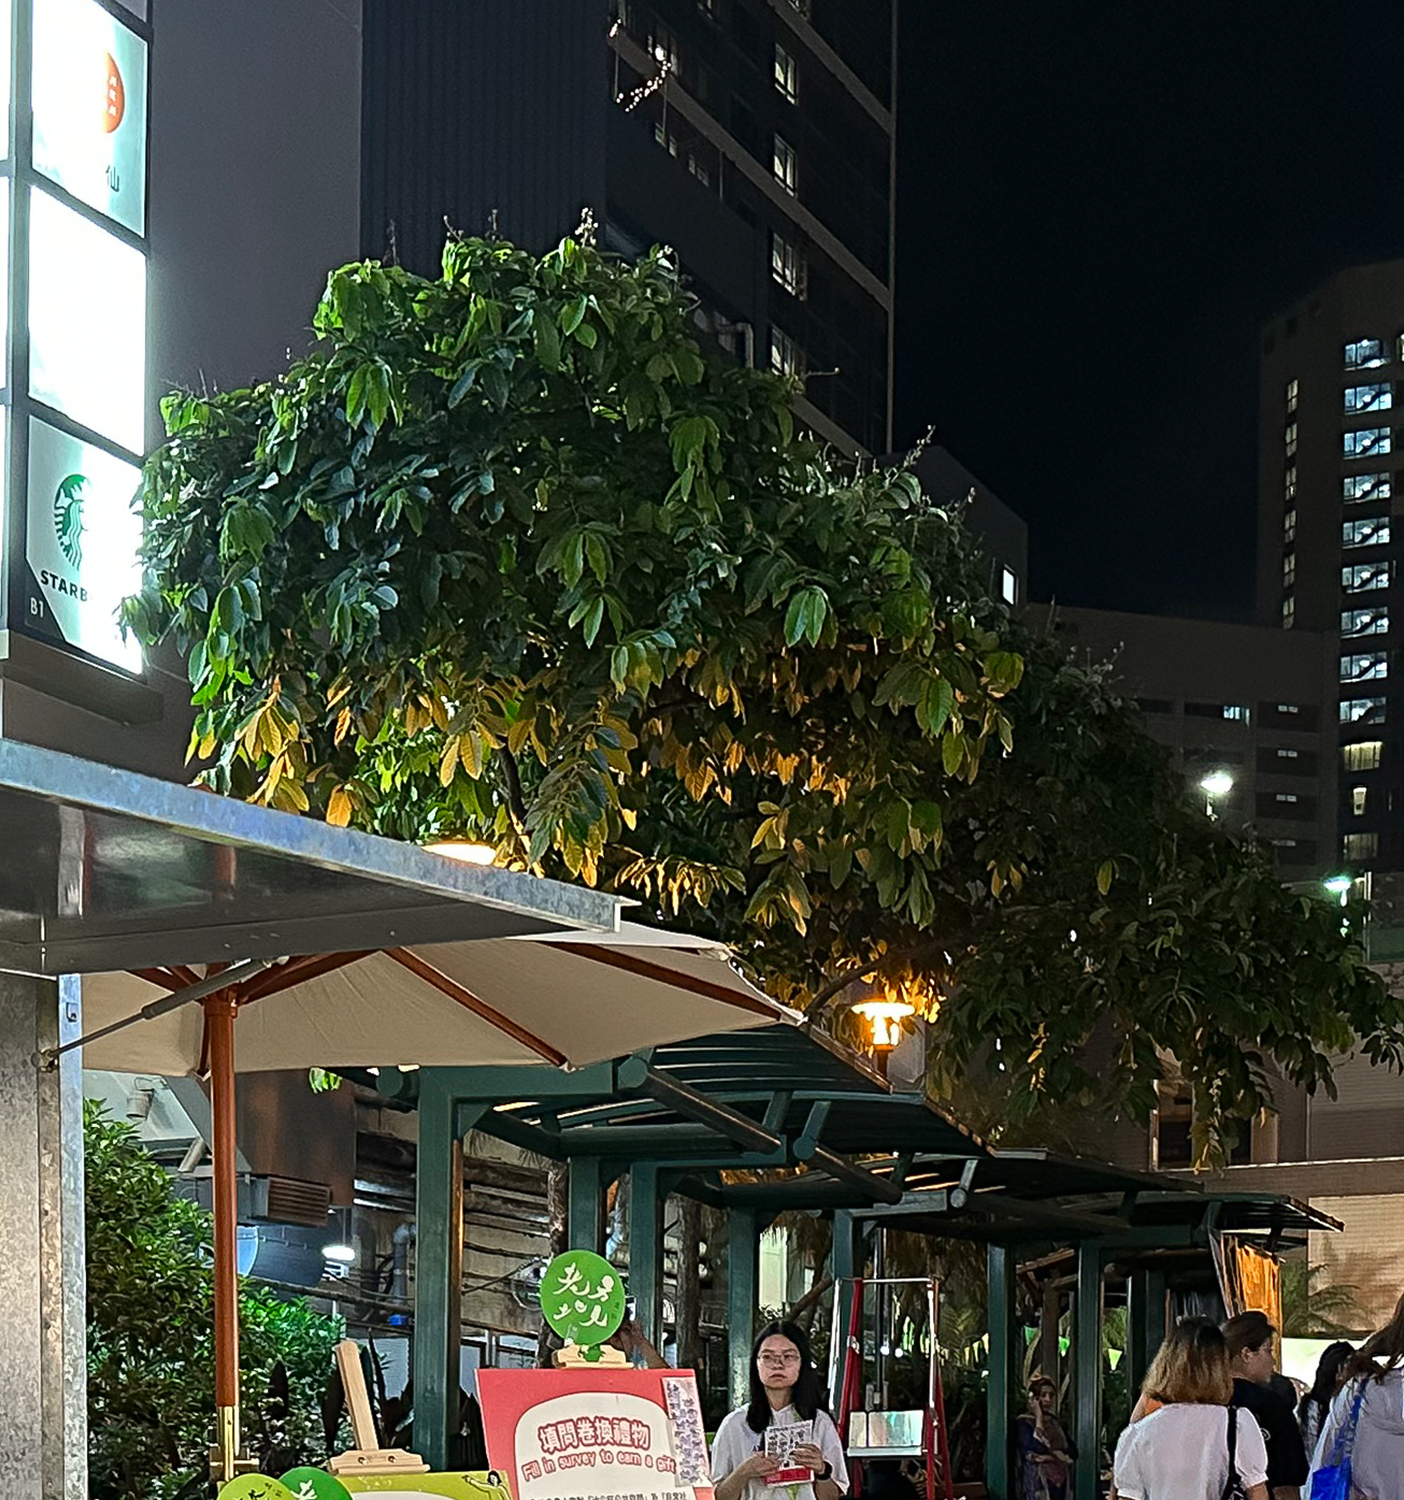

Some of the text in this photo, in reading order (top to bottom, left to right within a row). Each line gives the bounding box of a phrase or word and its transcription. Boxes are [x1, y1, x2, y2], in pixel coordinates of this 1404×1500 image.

[40, 569, 88, 602] STARB
[30, 597, 45, 618] B1
[537, 1416, 650, 1454] 填問卷換禮物
[521, 1449, 676, 1482] Fill in survey to earn a gift
